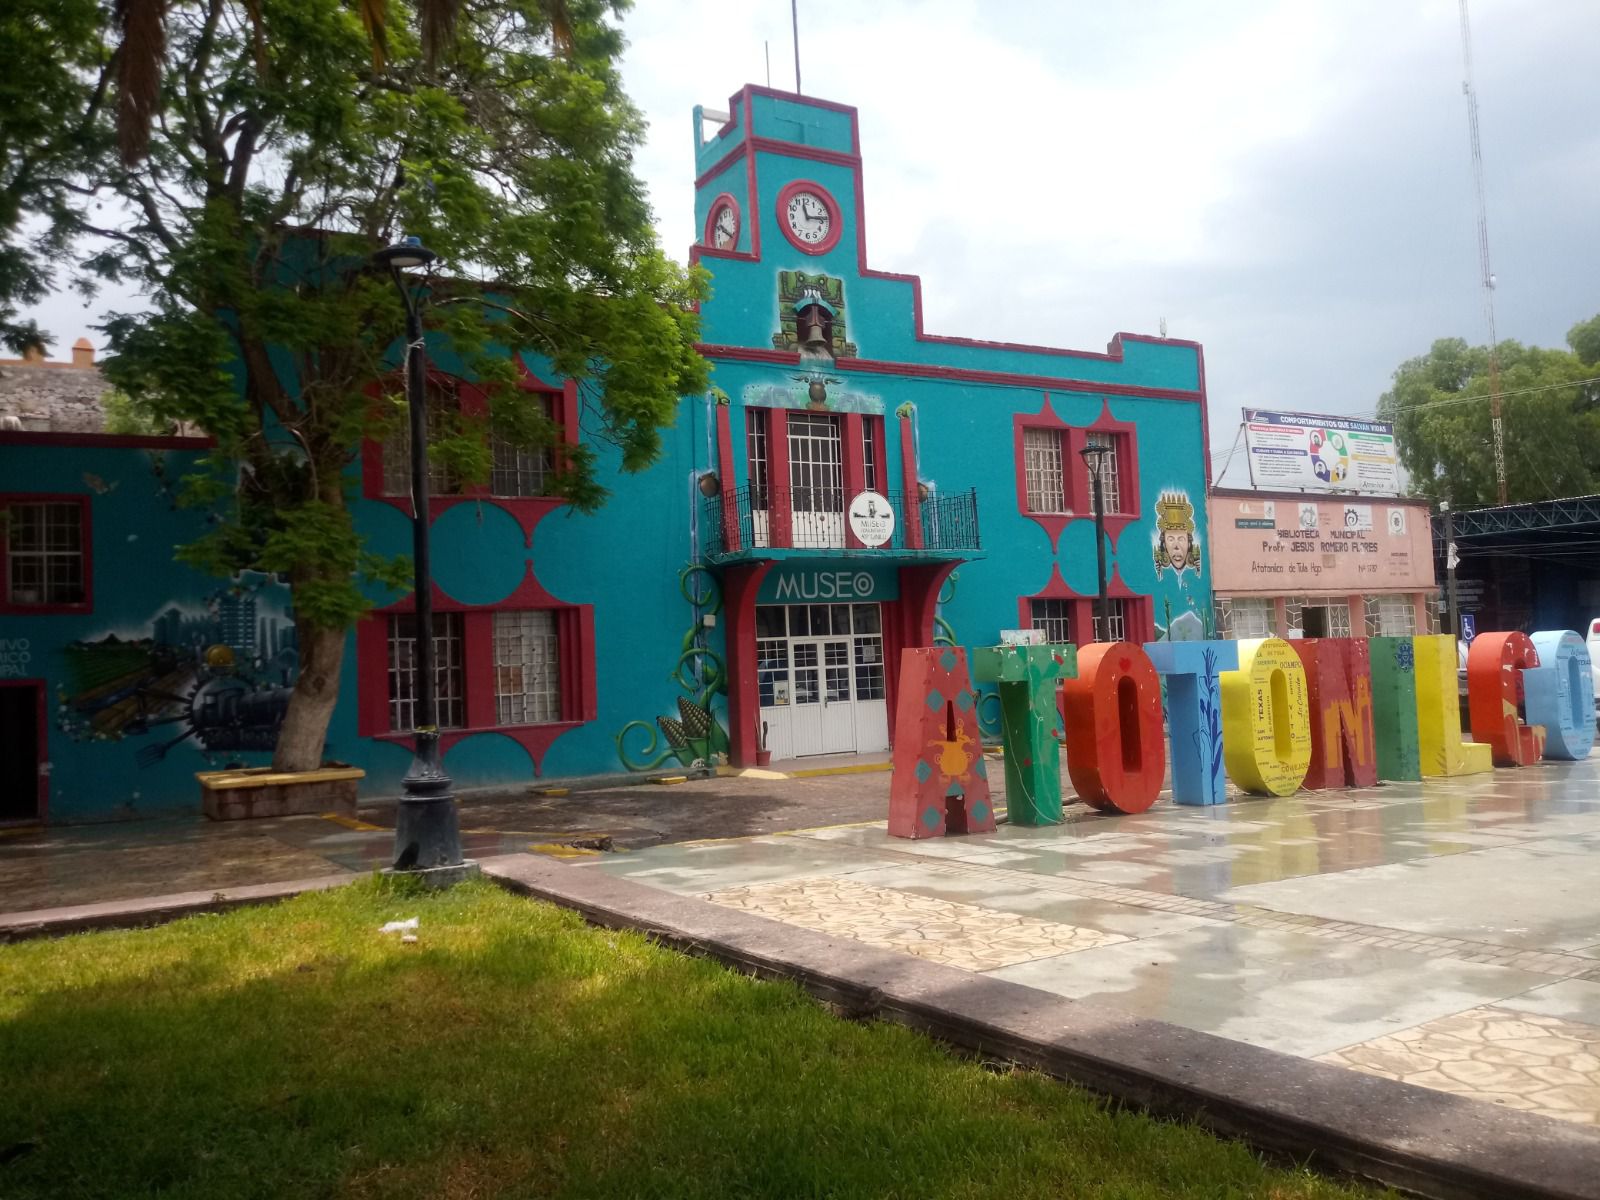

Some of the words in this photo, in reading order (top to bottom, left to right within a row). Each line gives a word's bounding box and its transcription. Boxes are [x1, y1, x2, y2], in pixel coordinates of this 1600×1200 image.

[1280, 416, 1337, 427] COMPORTAMIENTOS
[1338, 421, 1350, 429] QUE
[1350, 422, 1370, 431] SALVAN
[1371, 425, 1387, 433] VIDAS
[1276, 529, 1320, 539] BIBLIOTECA
[1330, 530, 1366, 539] MUNICIPAL
[1290, 542, 1315, 553] JESUS
[1320, 541, 1349, 553] ROMERO
[775, 571, 875, 600] MUSEO
[888, 630, 1596, 839] ATOTONILCO
